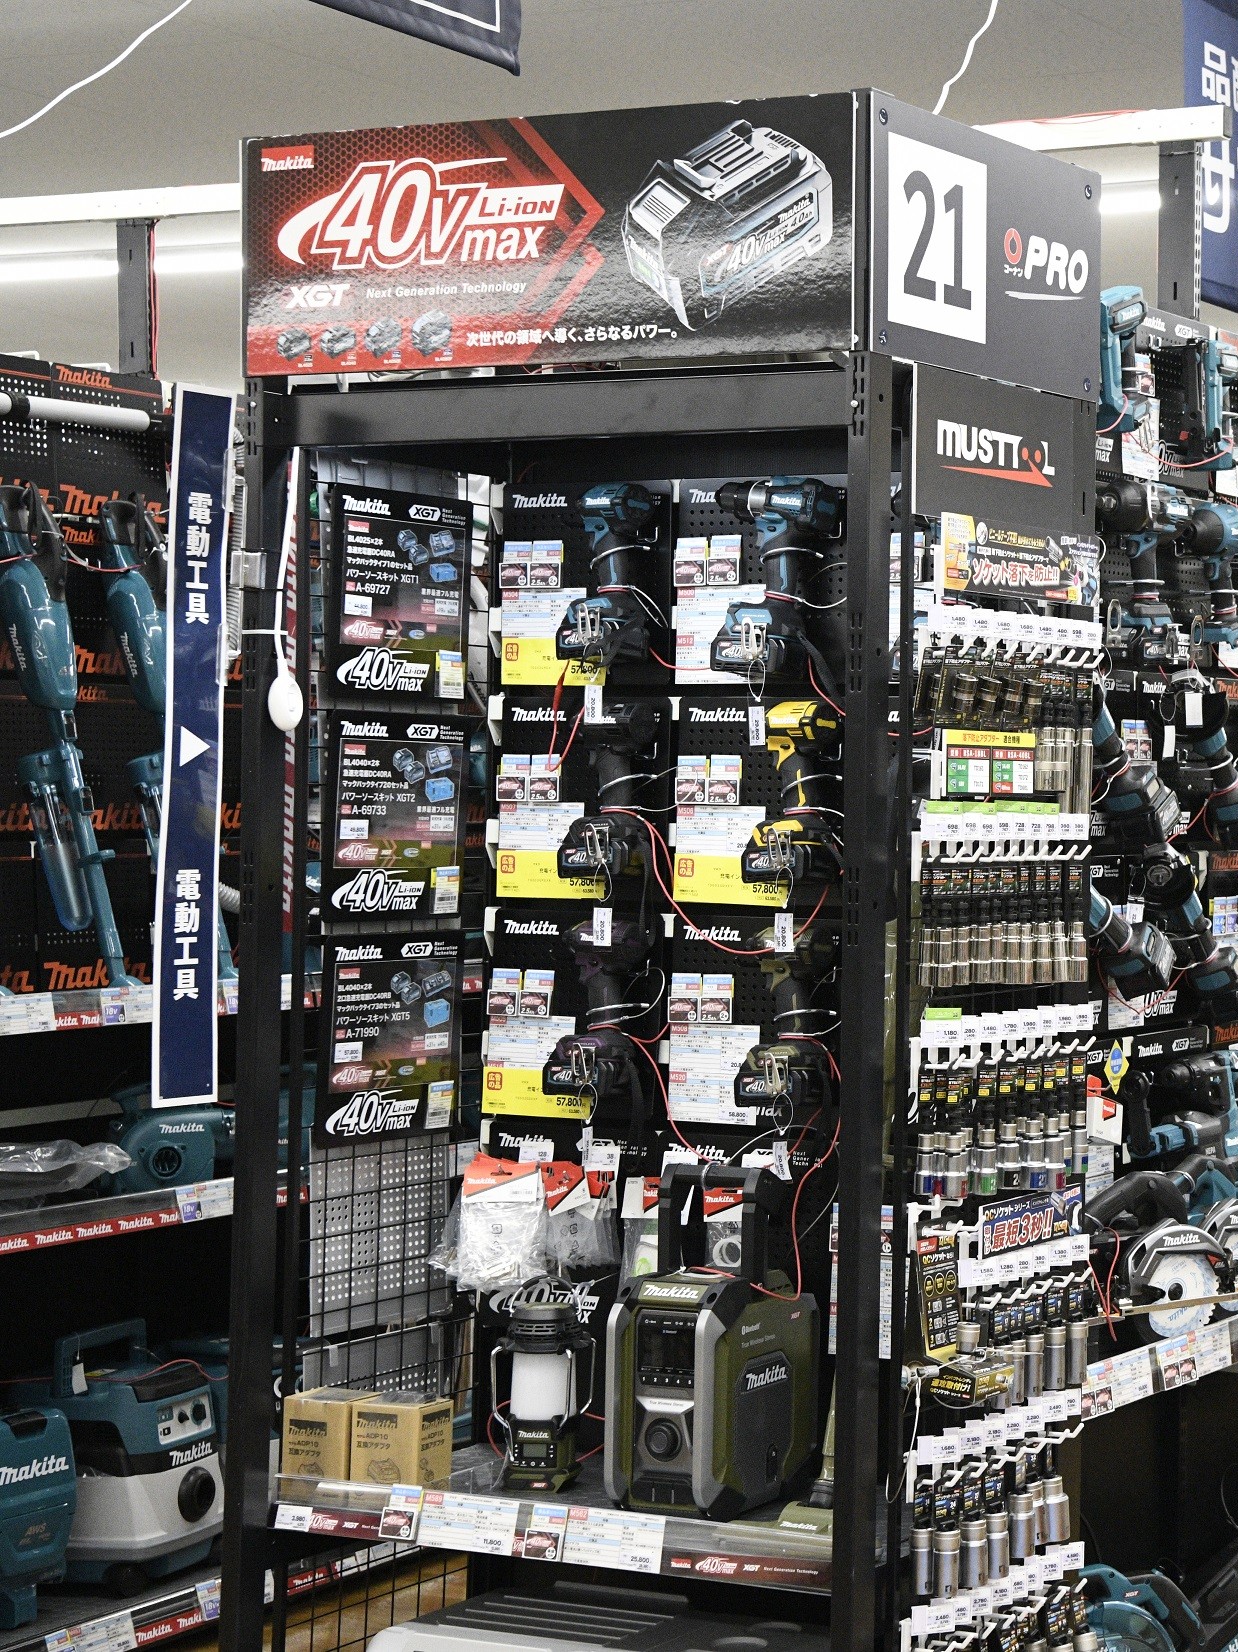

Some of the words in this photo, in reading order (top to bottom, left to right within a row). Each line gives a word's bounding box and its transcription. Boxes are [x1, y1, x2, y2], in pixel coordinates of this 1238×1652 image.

[903, 169, 973, 311] 21
[1023, 235, 1090, 295] PRO
[286, 284, 350, 308] XGT
[366, 287, 392, 299] Next
[395, 284, 458, 298] Generation
[461, 281, 528, 294] Technology
[413, 506, 438, 519] XGT
[185, 492, 213, 625] 電動工具
[346, 568, 399, 583] パワーソースキット
[355, 582, 391, 595] A-69727
[410, 725, 435, 737] XGT
[341, 791, 395, 802] パワーソースキット
[396, 793, 416, 803] XGT2
[351, 804, 387, 816] A-69733
[173, 868, 202, 1001] 電動工具
[406, 943, 430, 956] XGT
[335, 1012, 390, 1026] パワーソースキット
[390, 1011, 411, 1022] XGT5
[345, 1026, 380, 1040] A-71990
